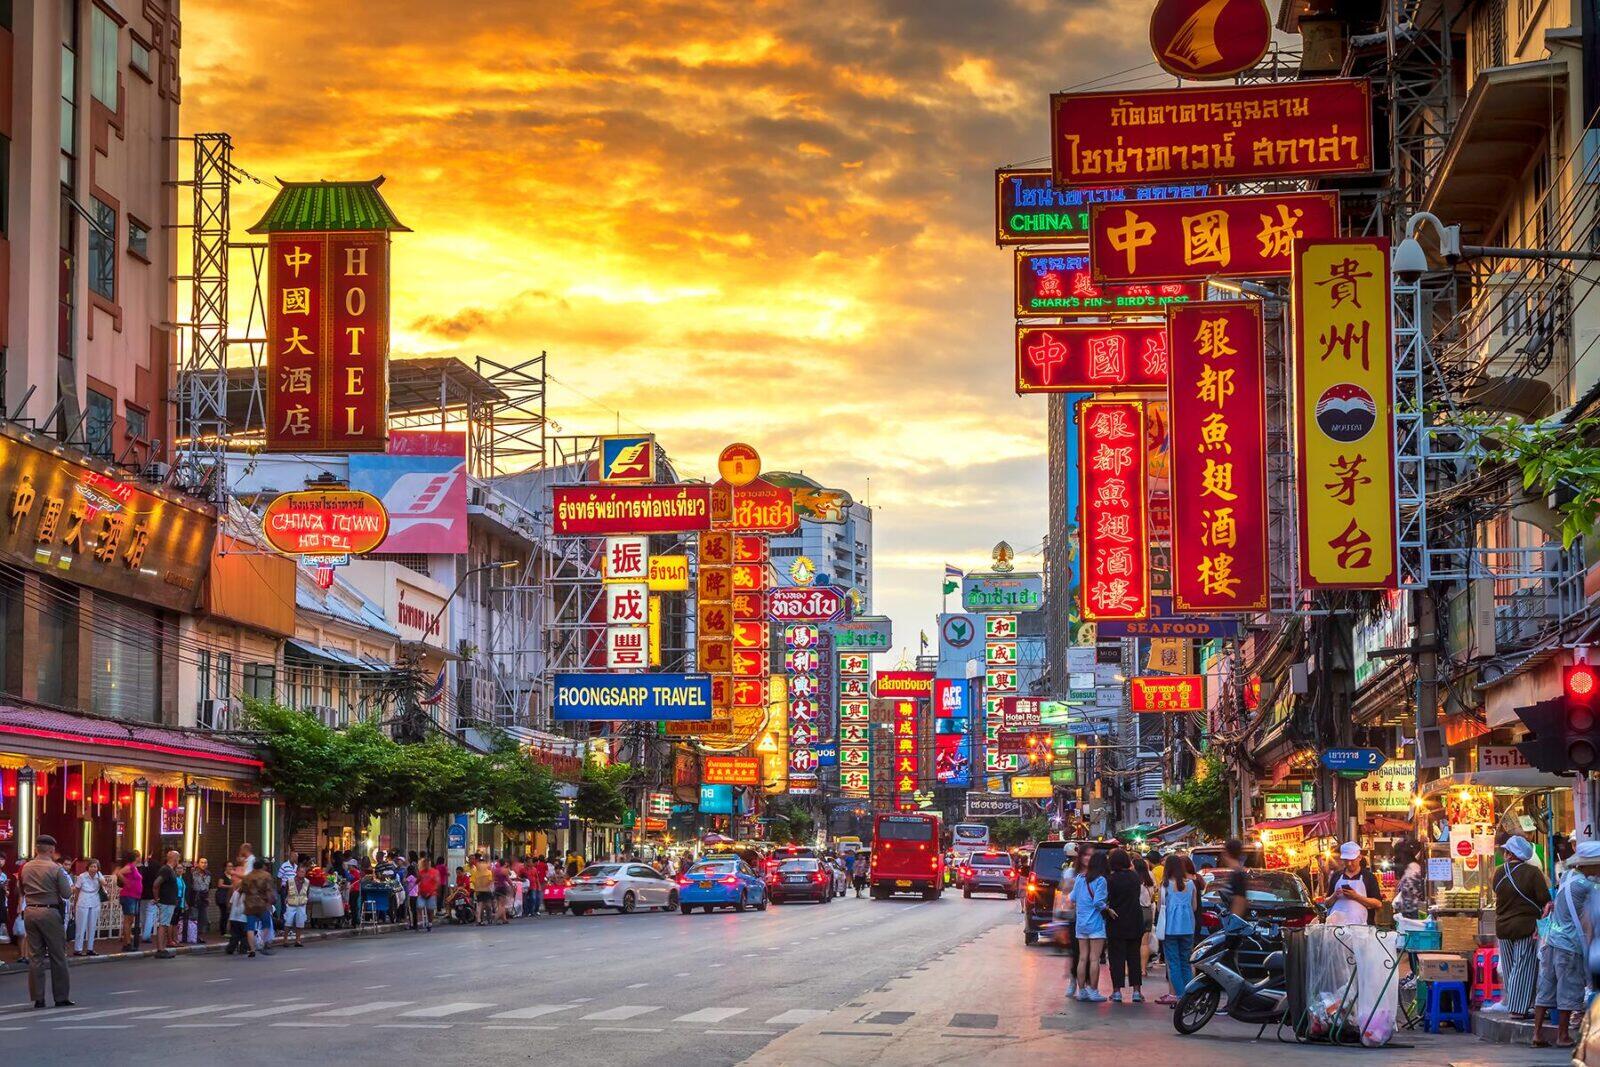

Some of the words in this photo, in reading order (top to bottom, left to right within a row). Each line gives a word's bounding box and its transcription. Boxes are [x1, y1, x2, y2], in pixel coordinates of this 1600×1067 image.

[1010, 213, 1073, 231] CHINA
[1107, 205, 1304, 275] 中國城
[1031, 296, 1080, 308] SHARK'S
[1116, 296, 1155, 307] BIRD'S
[280, 246, 313, 437] 中國大酒店
[344, 247, 369, 436] HOTEL
[1194, 317, 1242, 599] 銀都魚翅酒樓
[558, 487, 706, 530] รุ่งทรัพย์การท่องเที่ยว
[1089, 410, 1139, 612] 銀都魚翅酒樓
[272, 513, 325, 530] CHINA
[332, 514, 380, 532] TOWN
[299, 534, 351, 549] HOTEL
[612, 543, 643, 664] 振成豐
[771, 592, 837, 616] ทองใบ
[1126, 622, 1210, 634] SEAFOOD
[558, 686, 648, 706] ROONGSARP
[652, 686, 706, 706] TRAVEL
[943, 686, 962, 697] APP
[847, 655, 863, 788] 和成興大金行
[1005, 713, 1025, 721] Hotel
[1026, 713, 1040, 722] Roy
[817, 749, 835, 757] UOB
[899, 702, 914, 809] 聯成興大金
[1328, 751, 1359, 760] เยาวราช
[1368, 753, 1377, 764] 2
[1583, 824, 1592, 838] 4
